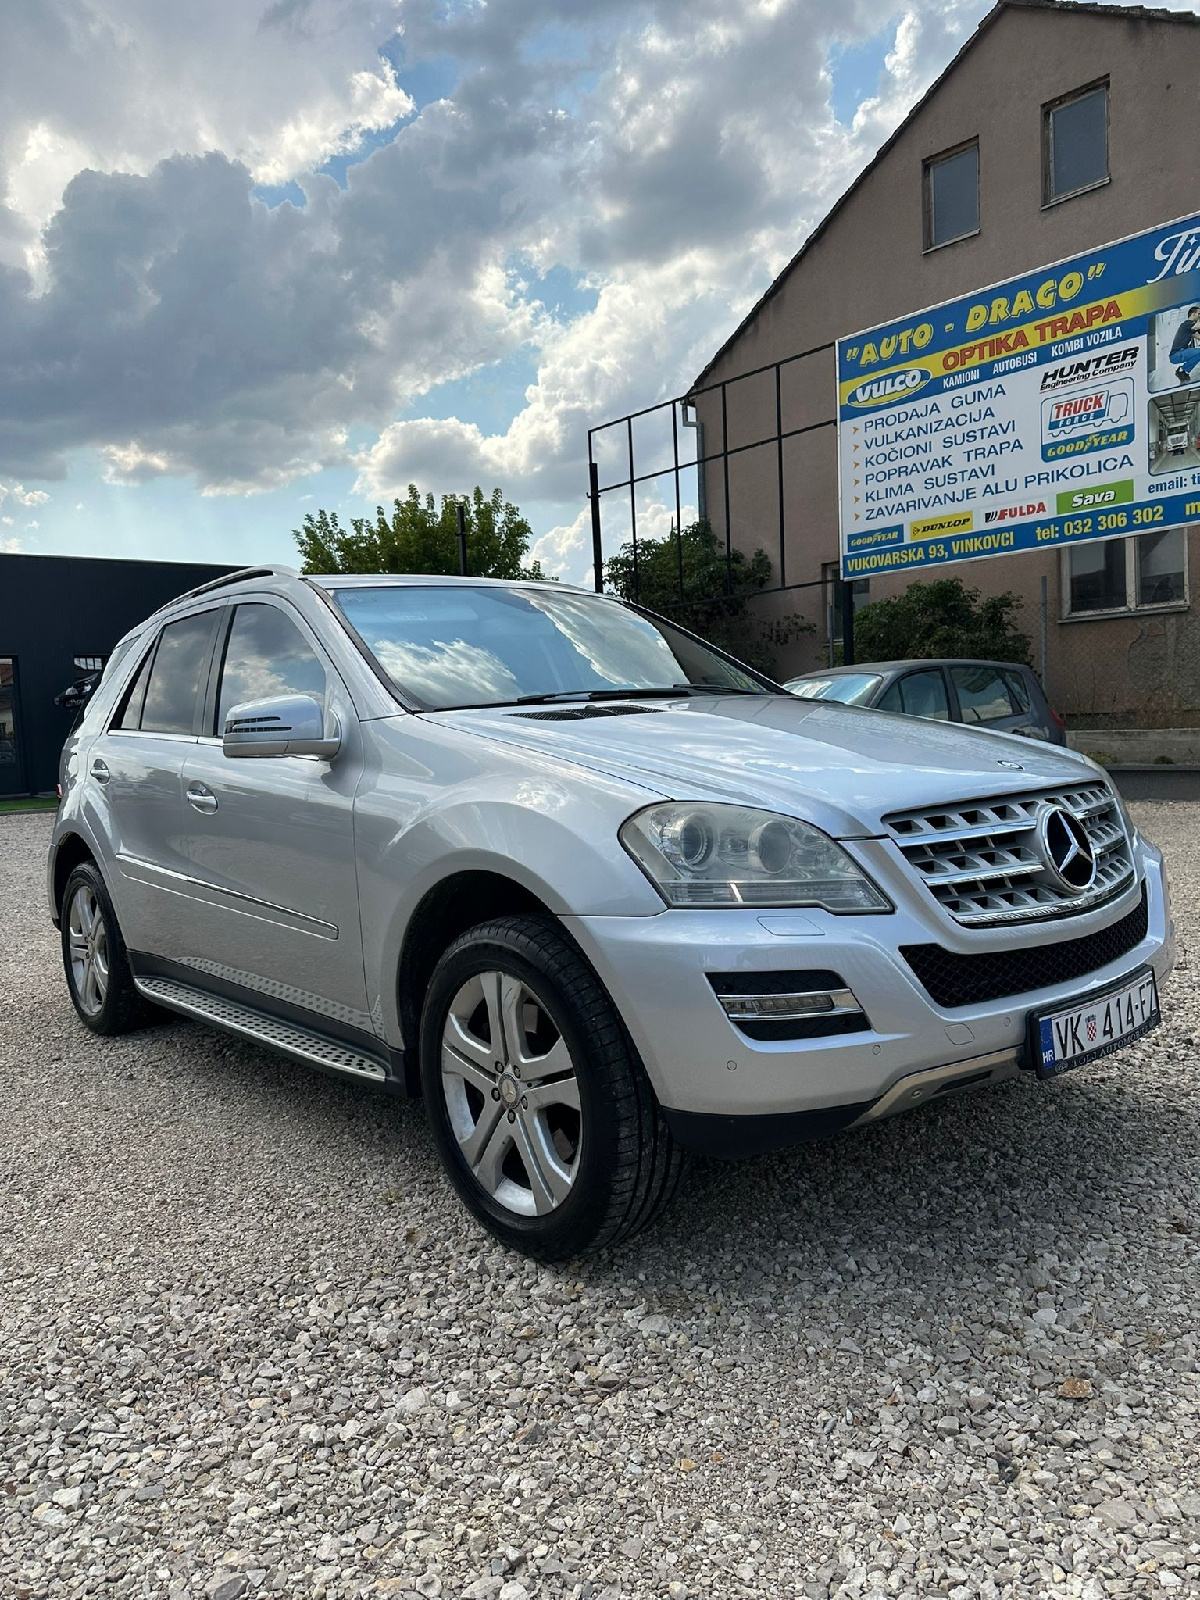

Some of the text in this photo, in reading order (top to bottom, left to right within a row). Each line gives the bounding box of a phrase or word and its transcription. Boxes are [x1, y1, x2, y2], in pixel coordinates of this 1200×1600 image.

[942, 300, 1122, 371] OPTIKA TRAPA
[943, 326, 1122, 389] KAMIONI AUTOBUSI KOMBI VOZILA
[1042, 346, 1139, 383] HUNTER
[855, 370, 921, 402] VULCO
[1040, 360, 1137, 391] Engineering Company
[864, 384, 1006, 433] PRODAJA GUMA
[1054, 393, 1104, 419] TRUCK
[1058, 412, 1095, 428] FORCE
[864, 407, 995, 450] VULKANIZACIJA
[865, 419, 1016, 468] KOČIONI SUSTAVI
[1047, 430, 1128, 457] GOODYEAR
[865, 439, 1024, 485] POPRAVAK TRAPA
[865, 464, 996, 503] KLIMA SUSTAVI
[865, 454, 1134, 521] ZAVARIVANJE ALU PRIKOLICA
[1071, 489, 1116, 508] Sava
[1148, 476, 1187, 493] email:
[921, 517, 971, 533] DUNLOP
[997, 502, 1047, 520] FULDA
[847, 547, 926, 572] VUKOVARSKA
[928, 544, 949, 564] 93,
[952, 531, 1014, 554] VINKOVCI
[1036, 523, 1060, 541] tel:
[1063, 518, 1092, 536] 032
[1097, 513, 1127, 531] 306
[1133, 505, 1164, 524] 302
[850, 530, 899, 547] GOODYEAR
[1056, 1013, 1084, 1058] VK
[1043, 1050, 1054, 1064] HR
